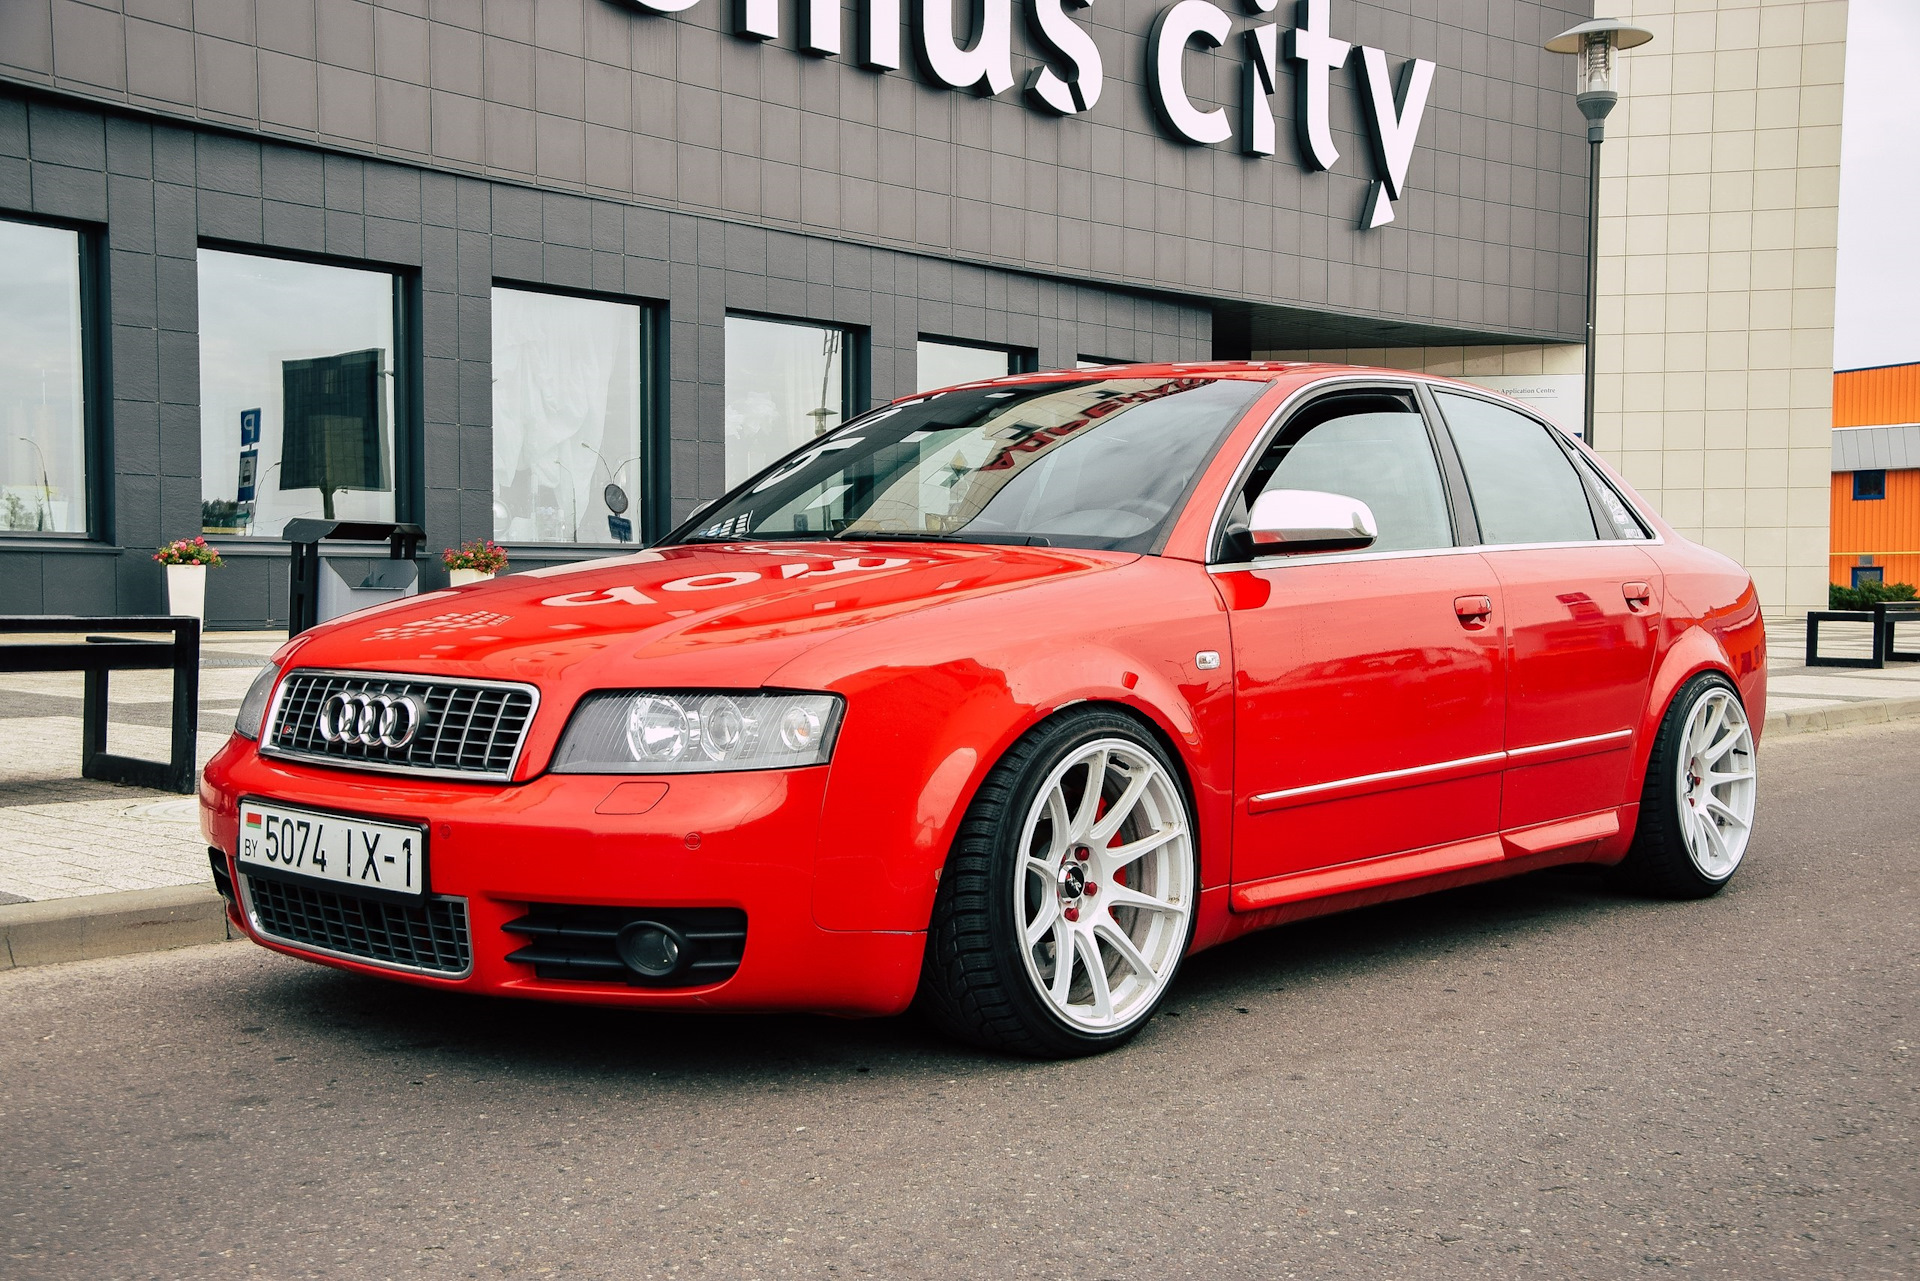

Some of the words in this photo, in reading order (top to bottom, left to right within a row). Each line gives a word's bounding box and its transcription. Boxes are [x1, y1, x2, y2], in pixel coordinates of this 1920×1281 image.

[1148, 0, 1436, 229] city
[244, 838, 259, 858] BY
[265, 815, 327, 872] 5074
[346, 829, 413, 888] IX-1
